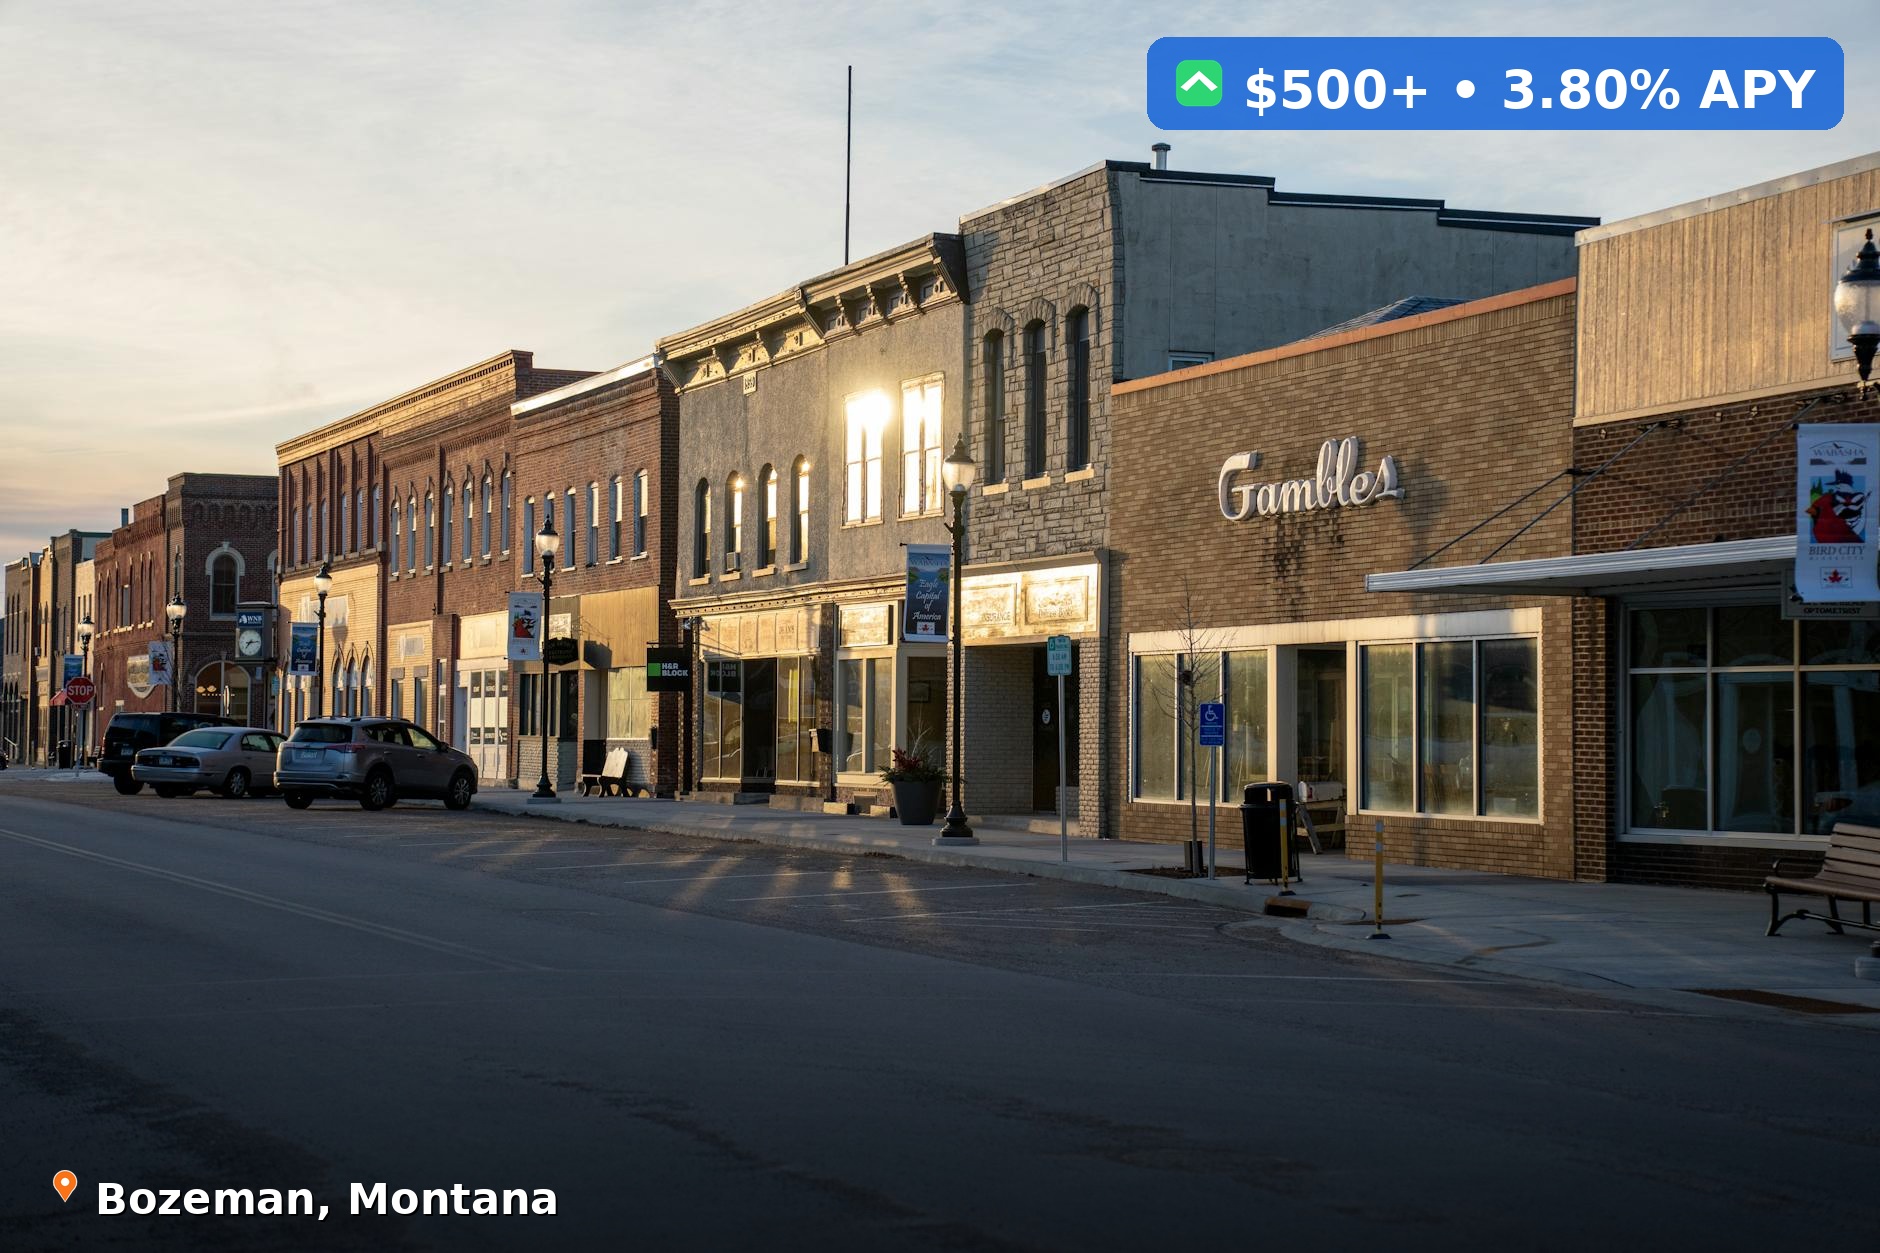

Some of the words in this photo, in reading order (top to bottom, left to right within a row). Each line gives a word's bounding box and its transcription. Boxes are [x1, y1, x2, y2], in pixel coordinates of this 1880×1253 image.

[1813, 448, 1865, 457] WABASHA
[1218, 436, 1405, 523] Gambles
[1809, 546, 1836, 555] BIRD
[1839, 545, 1865, 555] CITY
[919, 579, 939, 591] Eagle
[915, 590, 942, 604] Capital
[924, 600, 934, 611] of
[912, 611, 942, 621] America
[1803, 607, 1861, 615] OPTOMETRIST
[661, 662, 679, 670] H&R
[661, 669, 688, 677] BLOCK
[67, 685, 93, 696] STOP
